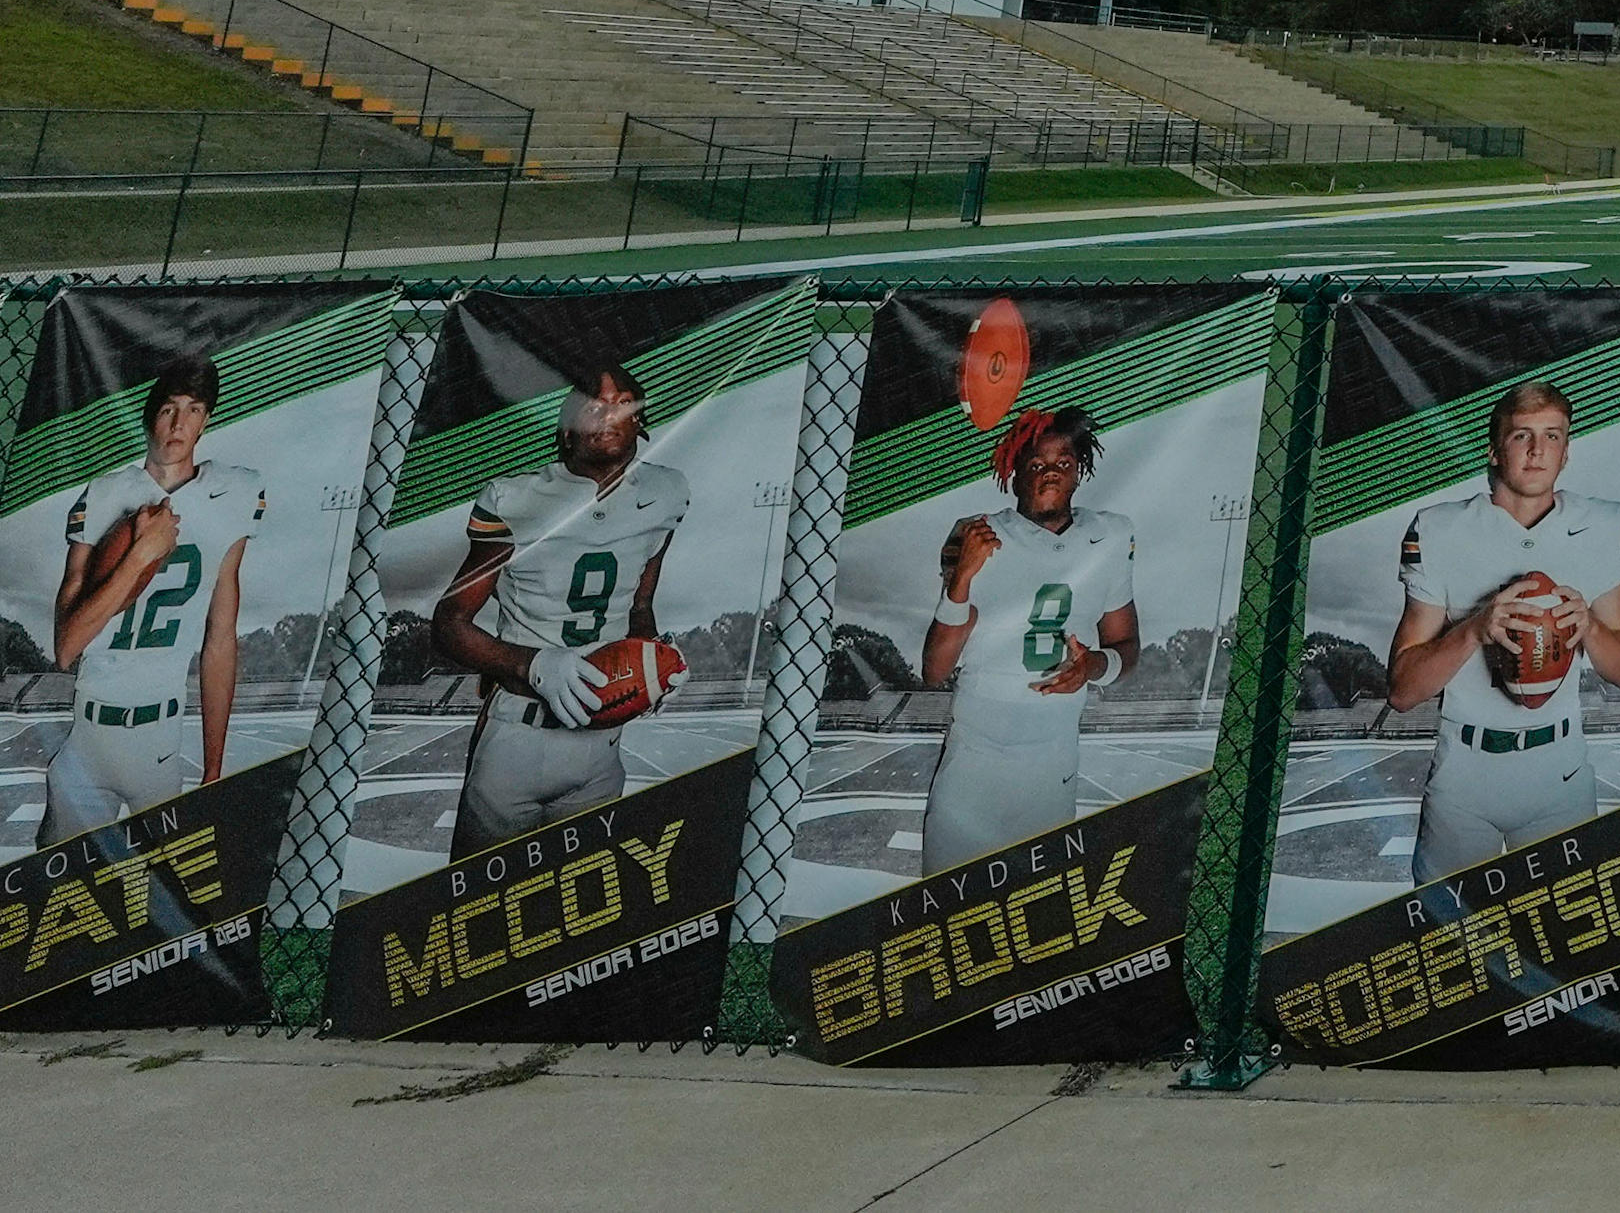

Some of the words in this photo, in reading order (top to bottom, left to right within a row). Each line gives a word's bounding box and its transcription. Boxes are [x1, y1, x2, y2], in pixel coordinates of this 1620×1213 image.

[109, 542, 201, 651] 12
[561, 551, 619, 647] 9
[1022, 582, 1075, 672] 8
[4, 806, 179, 895] COLLIN
[450, 811, 616, 898] BOBBY
[890, 828, 1086, 927] KAYDEN
[1405, 837, 1583, 928] RYDER
[383, 818, 685, 1008] MCCOY
[810, 843, 1149, 1045] BROCK
[90, 931, 208, 997] SENIOR
[525, 946, 635, 1008] SENIOR
[639, 913, 720, 964] 2026
[993, 973, 1096, 1031] SENIOR
[1095, 946, 1172, 992] 2026
[1503, 973, 1619, 1037] SENIOR
